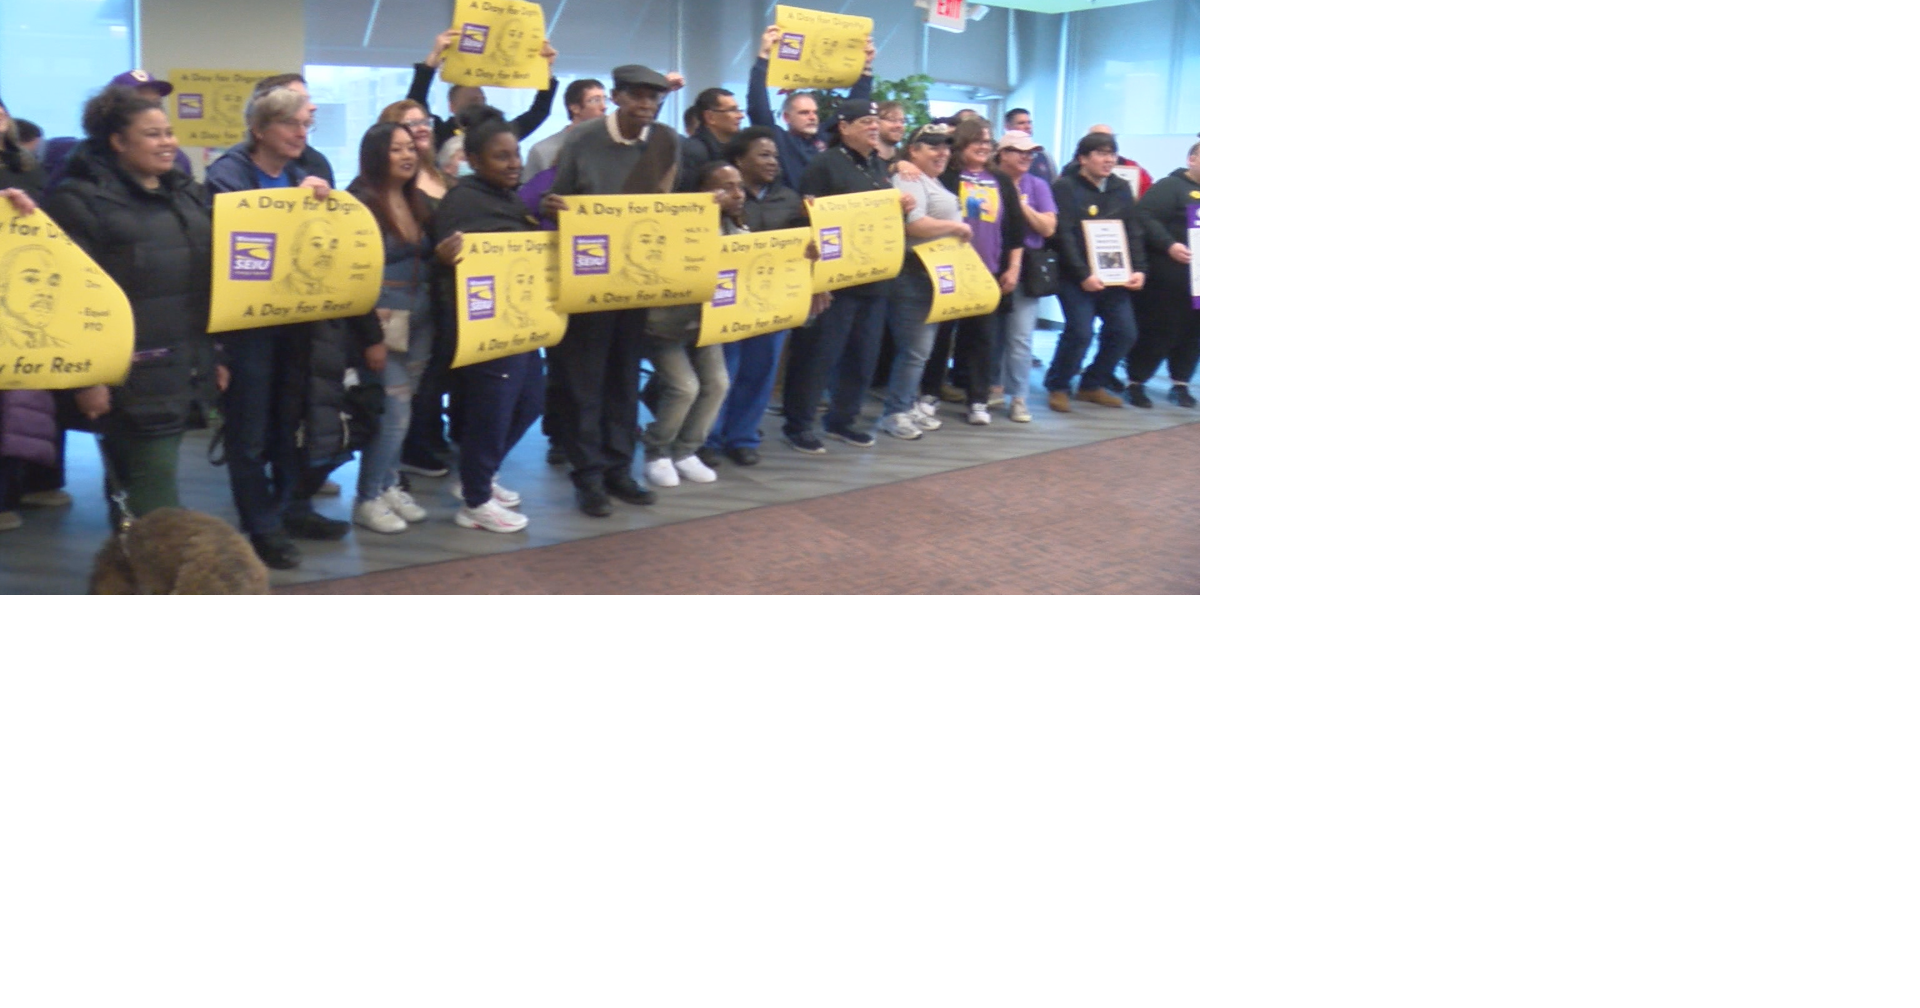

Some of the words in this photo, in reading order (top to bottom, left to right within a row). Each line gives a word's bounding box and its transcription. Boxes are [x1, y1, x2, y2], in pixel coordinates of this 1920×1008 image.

[470, 1, 478, 9] A
[236, 198, 250, 209] A
[258, 196, 296, 213] Day
[576, 204, 588, 215] A
[593, 203, 623, 217] Day
[628, 201, 648, 213] for
[654, 201, 706, 216] Dignity
[9, 215, 40, 236] for
[469, 243, 478, 254] A
[482, 241, 503, 255] Day
[507, 240, 523, 252] for
[721, 244, 729, 253] A
[731, 241, 750, 252] Day
[753, 239, 767, 249] for
[770, 237, 802, 249] Dignity
[234, 259, 271, 270] SEIU
[587, 294, 597, 303] A
[603, 292, 631, 304] Day
[636, 290, 657, 301] for
[661, 289, 692, 299] Rest
[243, 305, 254, 317] A
[260, 303, 290, 316] Day
[295, 301, 317, 313] for
[321, 300, 353, 311] Rest
[720, 325, 728, 333] A
[731, 322, 752, 332] Day
[477, 342, 485, 352] A
[13, 356, 43, 375] for
[51, 356, 93, 374] Rest
